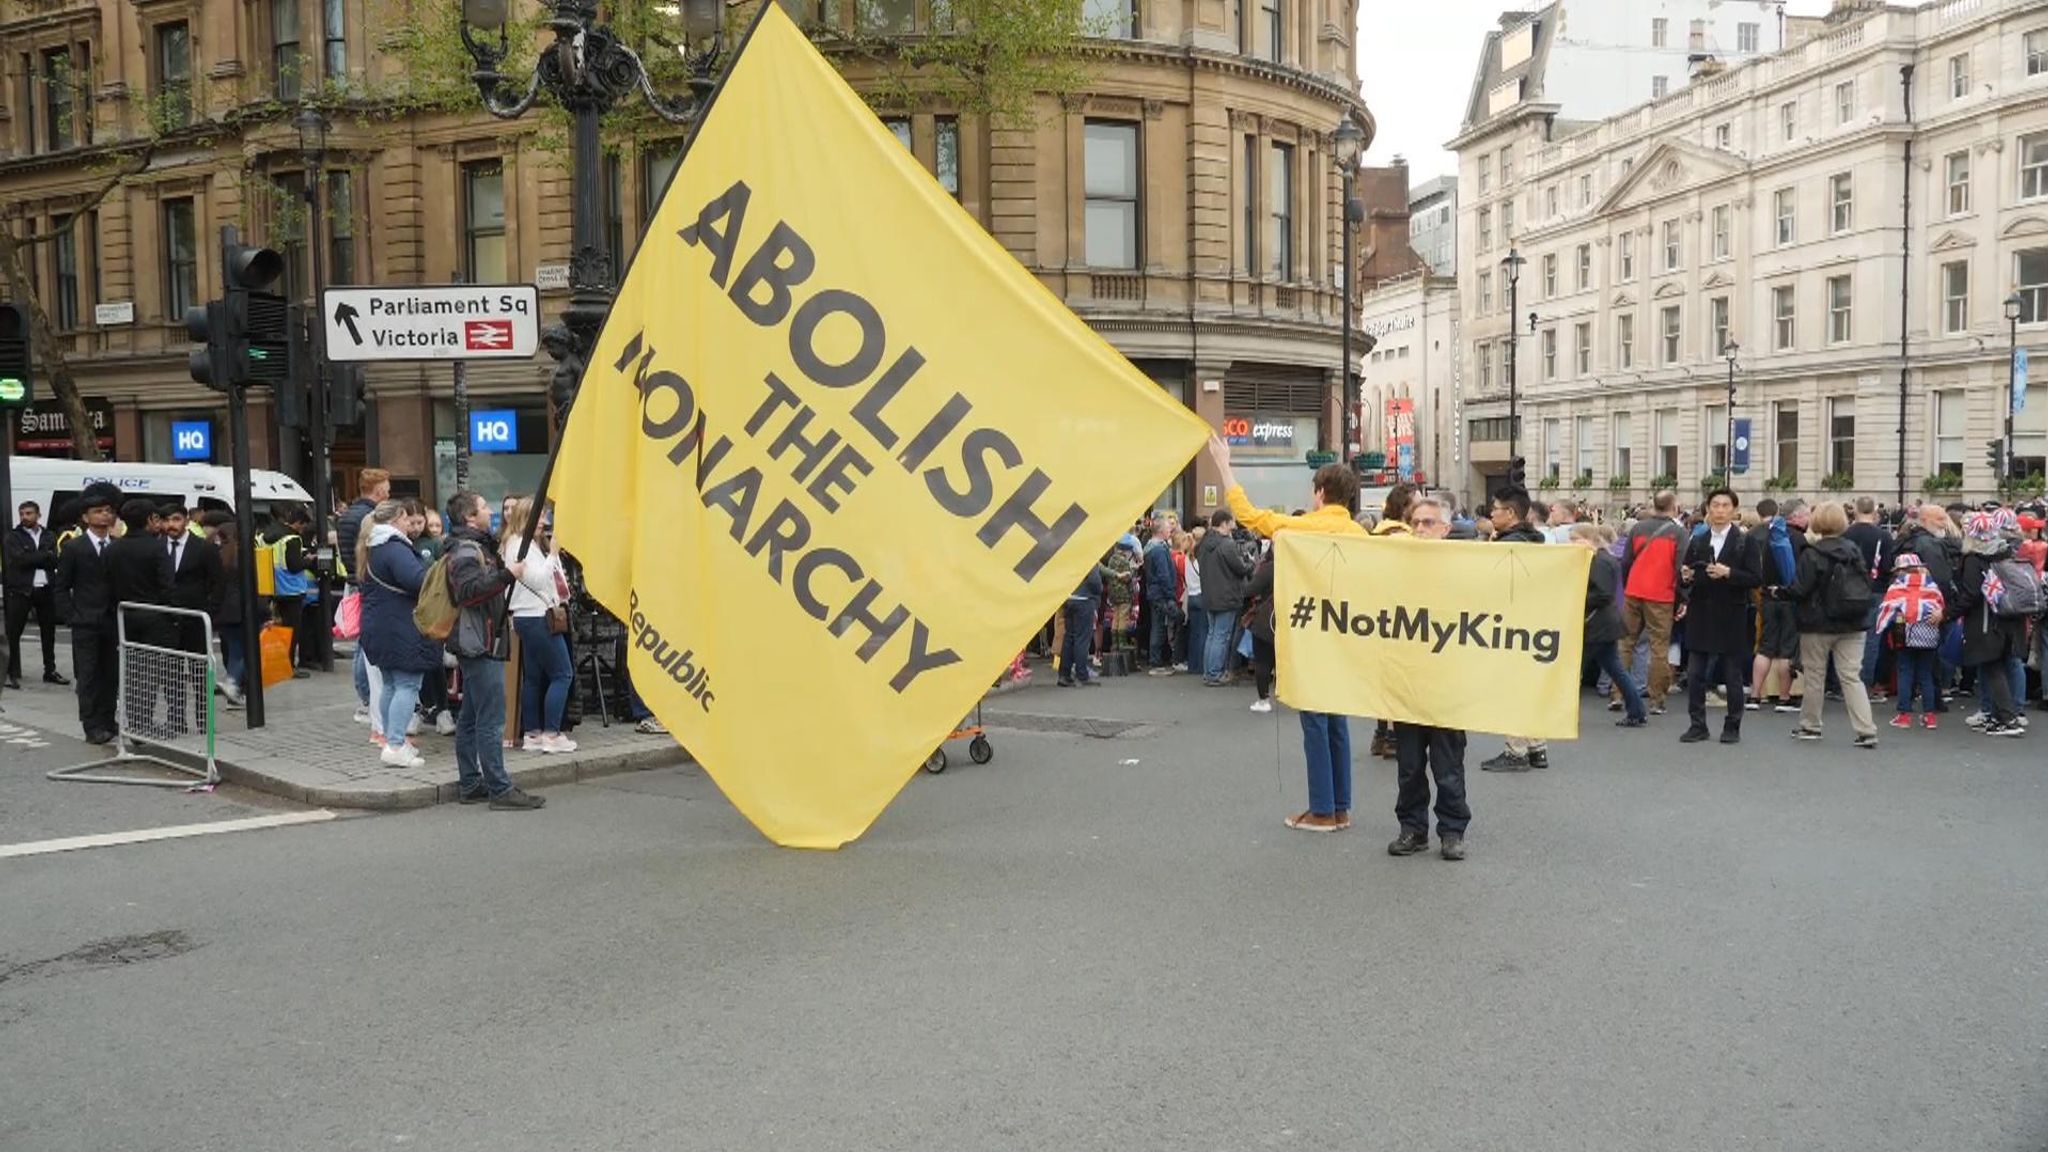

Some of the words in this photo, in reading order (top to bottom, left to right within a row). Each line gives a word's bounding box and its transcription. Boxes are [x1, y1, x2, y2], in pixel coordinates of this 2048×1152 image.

[370, 296, 490, 316] Parliament
[499, 295, 528, 315] Sq
[372, 328, 459, 347] Victoria
[676, 179, 1089, 583] ABOLISH
[178, 430, 204, 450] HQ
[477, 420, 509, 442] HQ
[1253, 422, 1293, 441] express
[743, 371, 874, 515] THE
[1290, 596, 1561, 664] #NotMyKing
[629, 588, 715, 713] Republic
